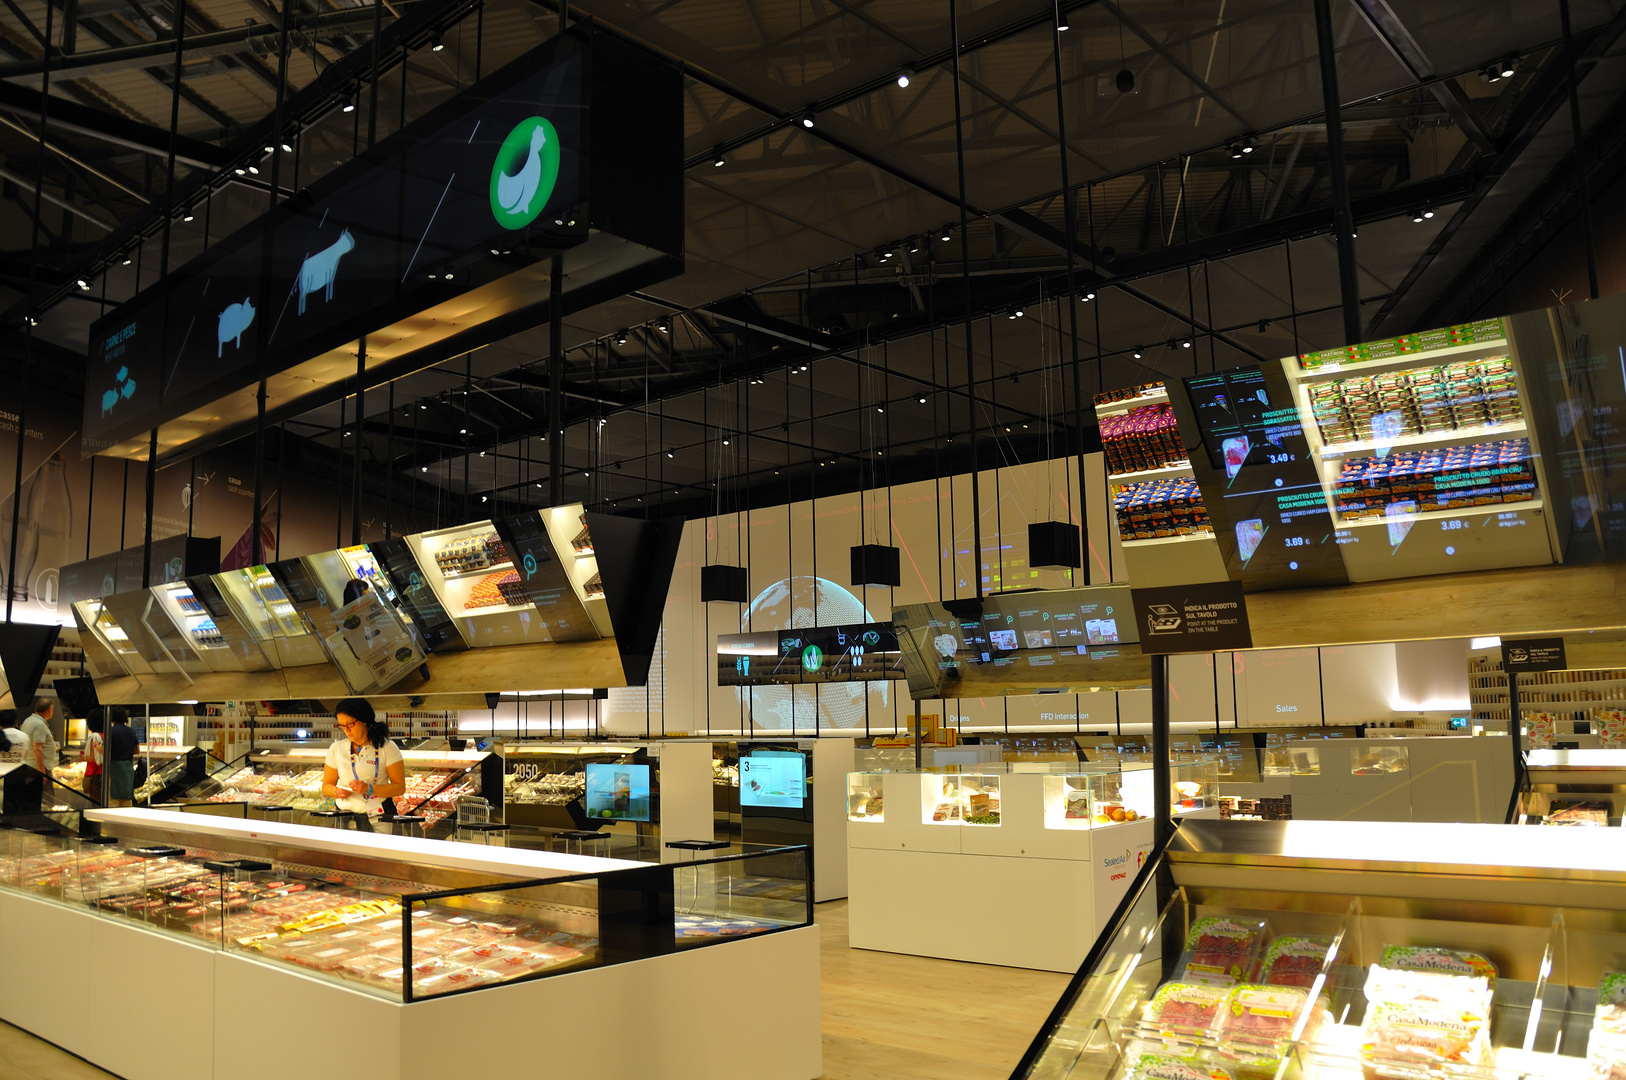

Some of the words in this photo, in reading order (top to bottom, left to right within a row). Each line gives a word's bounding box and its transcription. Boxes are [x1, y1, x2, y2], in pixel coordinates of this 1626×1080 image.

[123, 322, 137, 340] PESCE
[0, 411, 19, 422] casse
[1262, 408, 1293, 419] PROSCIUTTO
[1270, 453, 1288, 464] 3.49
[1434, 473, 1470, 482] PROSCIUTTO
[1435, 482, 1450, 490] CASA
[1451, 480, 1476, 488] MODENA
[1514, 483, 1535, 491] MODENA
[1278, 492, 1309, 502] PROSCIUTTO
[1279, 501, 1291, 510] CASA
[1292, 499, 1314, 508] MODENA
[1441, 520, 1462, 531] 3.69
[1285, 537, 1303, 547] 3.69
[1184, 604, 1202, 612] INDICA
[1208, 602, 1238, 610] PRODOTTO
[1276, 704, 1298, 712] Sales
[950, 714, 970, 723] Oriins
[513, 763, 538, 779] 2050
[744, 761, 750, 772] 3
[1397, 958, 1472, 973] CasaModena
[1388, 1014, 1467, 1031] CasaModena
[1146, 1069, 1202, 1080] CasaMod
